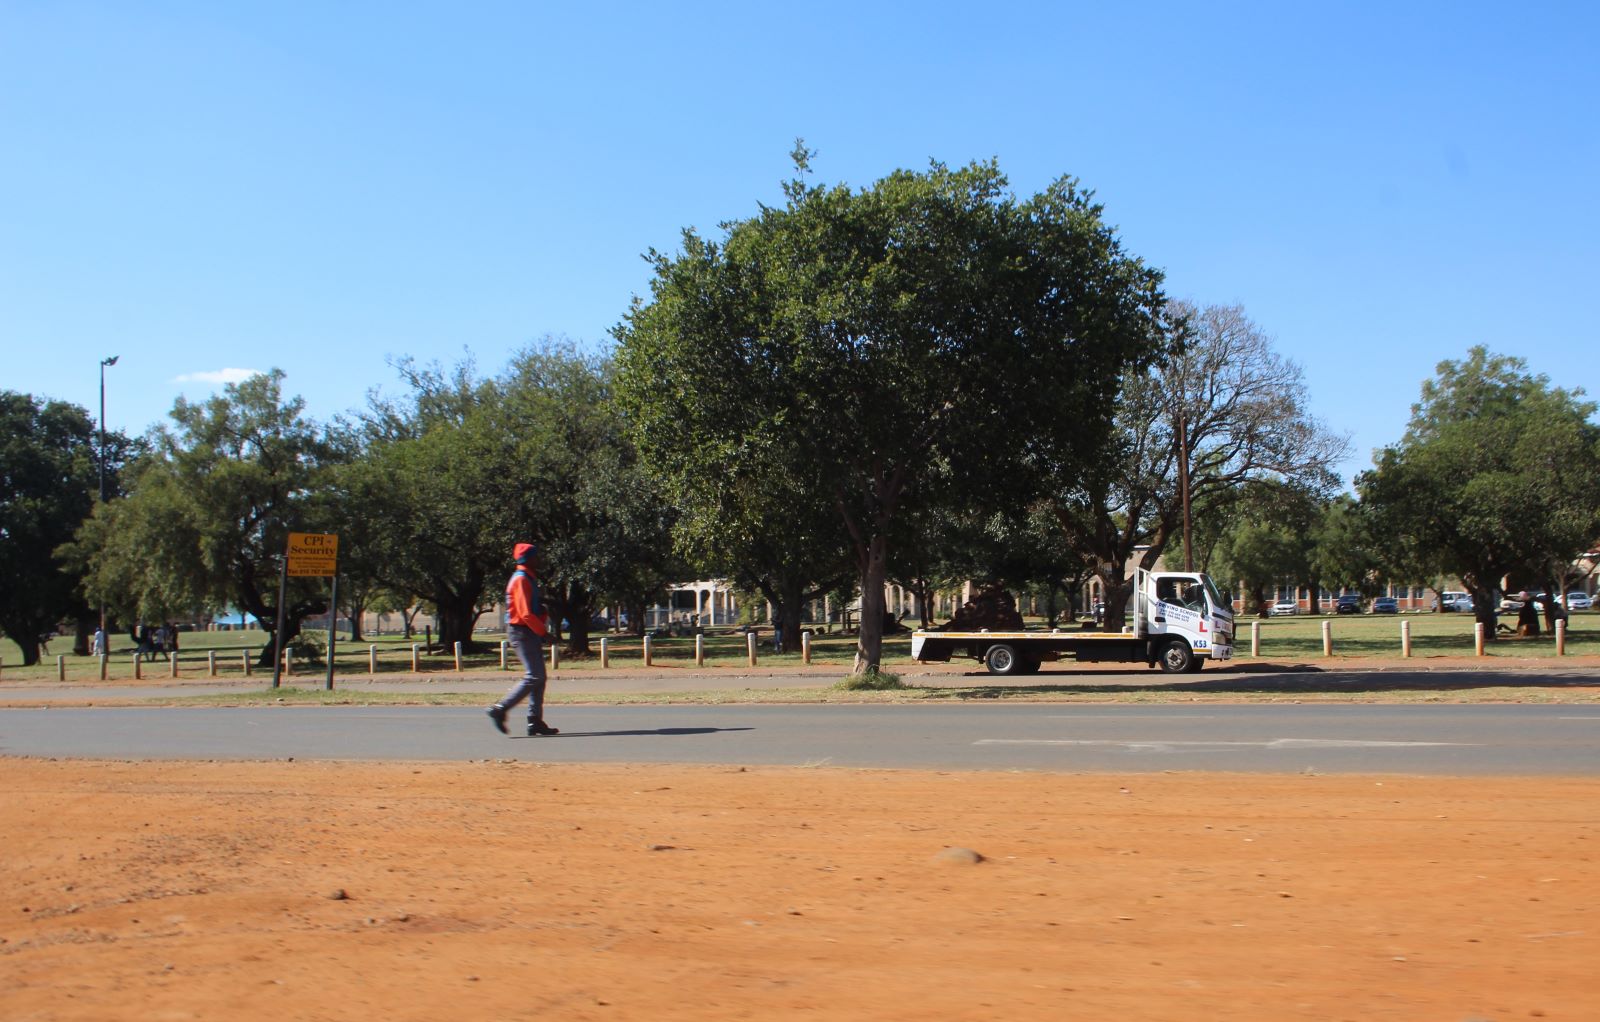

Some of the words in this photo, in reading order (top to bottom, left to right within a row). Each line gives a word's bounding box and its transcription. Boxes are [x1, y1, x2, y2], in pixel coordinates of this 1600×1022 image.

[304, 535, 324, 546] CPI
[291, 545, 335, 557] Security
[1158, 602, 1179, 612] DRIVING
[1180, 608, 1199, 618] SCHOOL
[1199, 621, 1208, 632] L
[1194, 640, 1207, 648] K53
